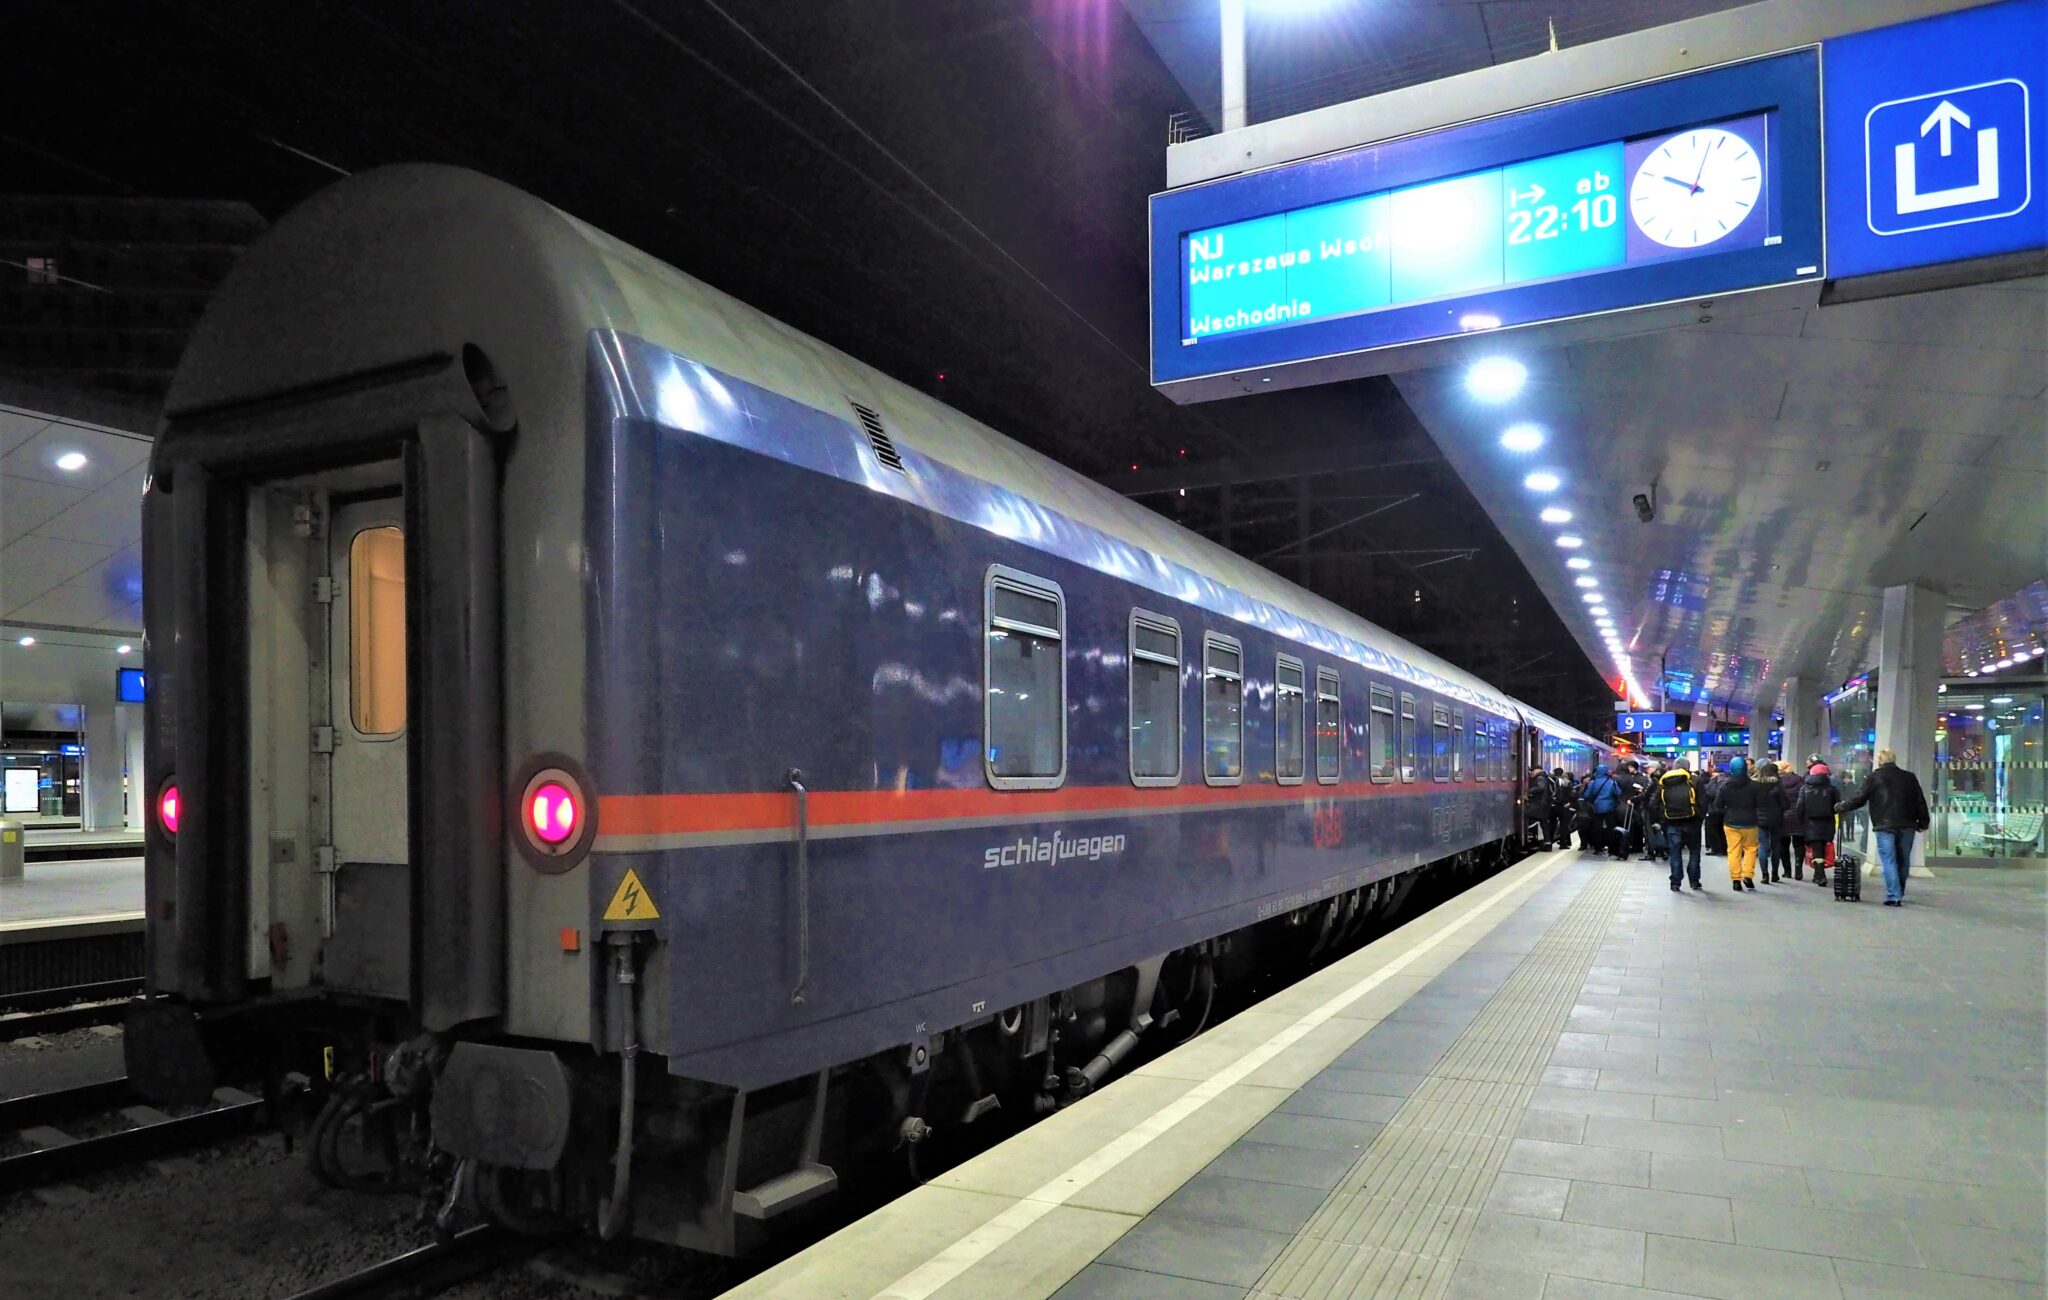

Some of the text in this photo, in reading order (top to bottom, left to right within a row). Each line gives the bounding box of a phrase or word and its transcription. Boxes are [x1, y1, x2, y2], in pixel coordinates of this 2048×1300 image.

[1576, 170, 1610, 195] ab
[1508, 193, 1617, 245] 22:10
[1190, 233, 1224, 263] NJ
[1190, 248, 1311, 285] Warszawa
[1190, 299, 1312, 336] Wschodnia
[1625, 717, 1653, 730] 9 D
[984, 830, 1126, 869] schlafwagen
[915, 1022, 926, 1033] WC
